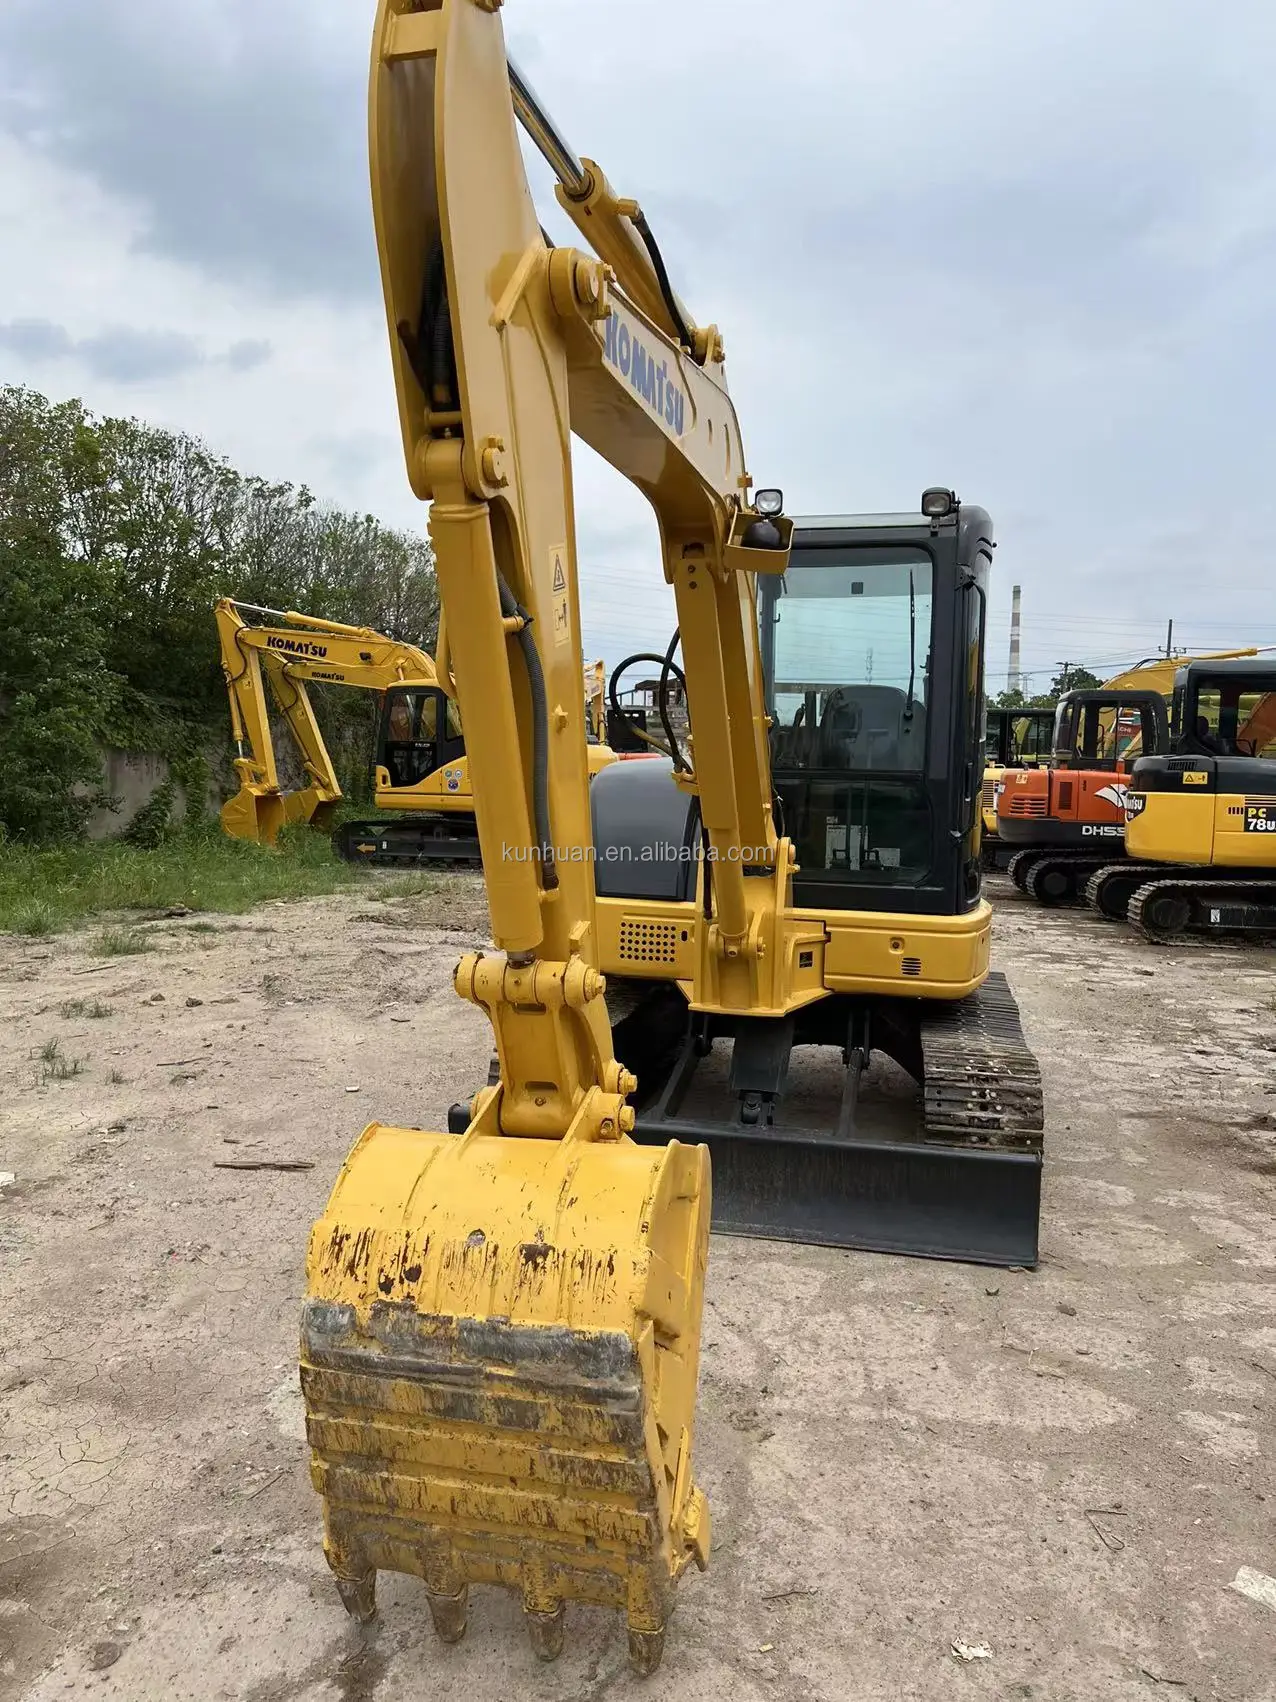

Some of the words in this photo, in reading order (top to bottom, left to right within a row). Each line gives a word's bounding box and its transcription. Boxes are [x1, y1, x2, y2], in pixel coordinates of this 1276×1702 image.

[604, 311, 684, 437] KOMATSU
[267, 636, 327, 657] KOMATSU
[312, 671, 345, 681] KOMATSU
[1247, 807, 1267, 818] PC
[1247, 818, 1276, 831] 78U
